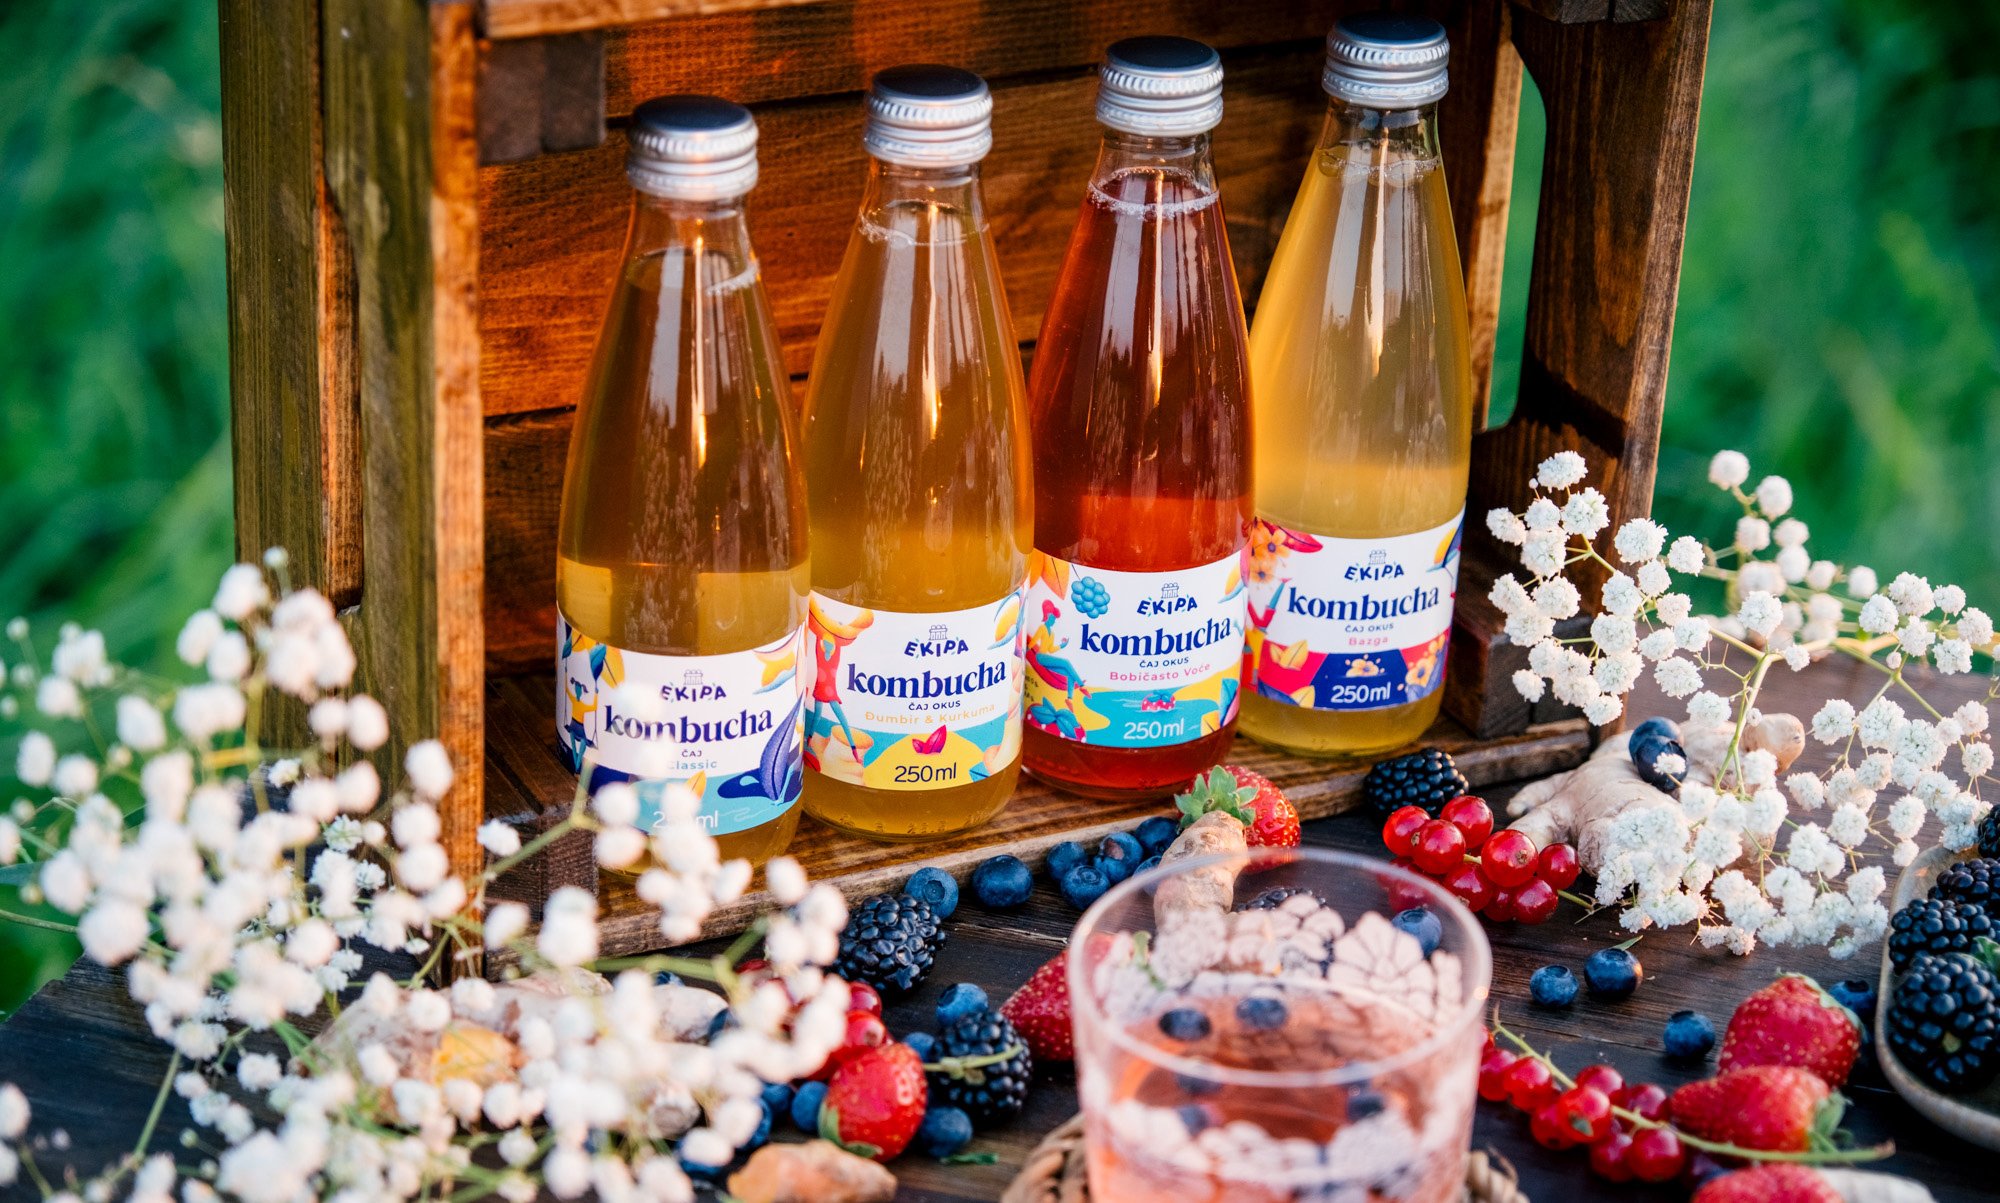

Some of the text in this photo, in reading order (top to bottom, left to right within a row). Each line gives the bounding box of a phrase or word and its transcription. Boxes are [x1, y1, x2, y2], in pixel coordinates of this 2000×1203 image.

[1344, 563, 1405, 581] EKIPA
[1136, 596, 1198, 615] EKIPA
[1287, 586, 1440, 621] kombucha
[1079, 617, 1231, 656] kombucha
[1344, 622, 1394, 633] ČAJ OKUS
[903, 638, 969, 658] EKIPA
[1348, 636, 1389, 647] Bazga
[1139, 656, 1189, 669] ČAJ OKUS
[846, 661, 1007, 699] kombucha
[1109, 670, 1179, 682] Bobičasto
[660, 683, 727, 702] EKIPA
[865, 703, 995, 724] Đumbir & Kurkuma
[908, 699, 961, 711] ČAJ OKUS
[604, 704, 774, 744] kombucha
[681, 748, 703, 758] ČAJ
[652, 809, 719, 829] 2ml
